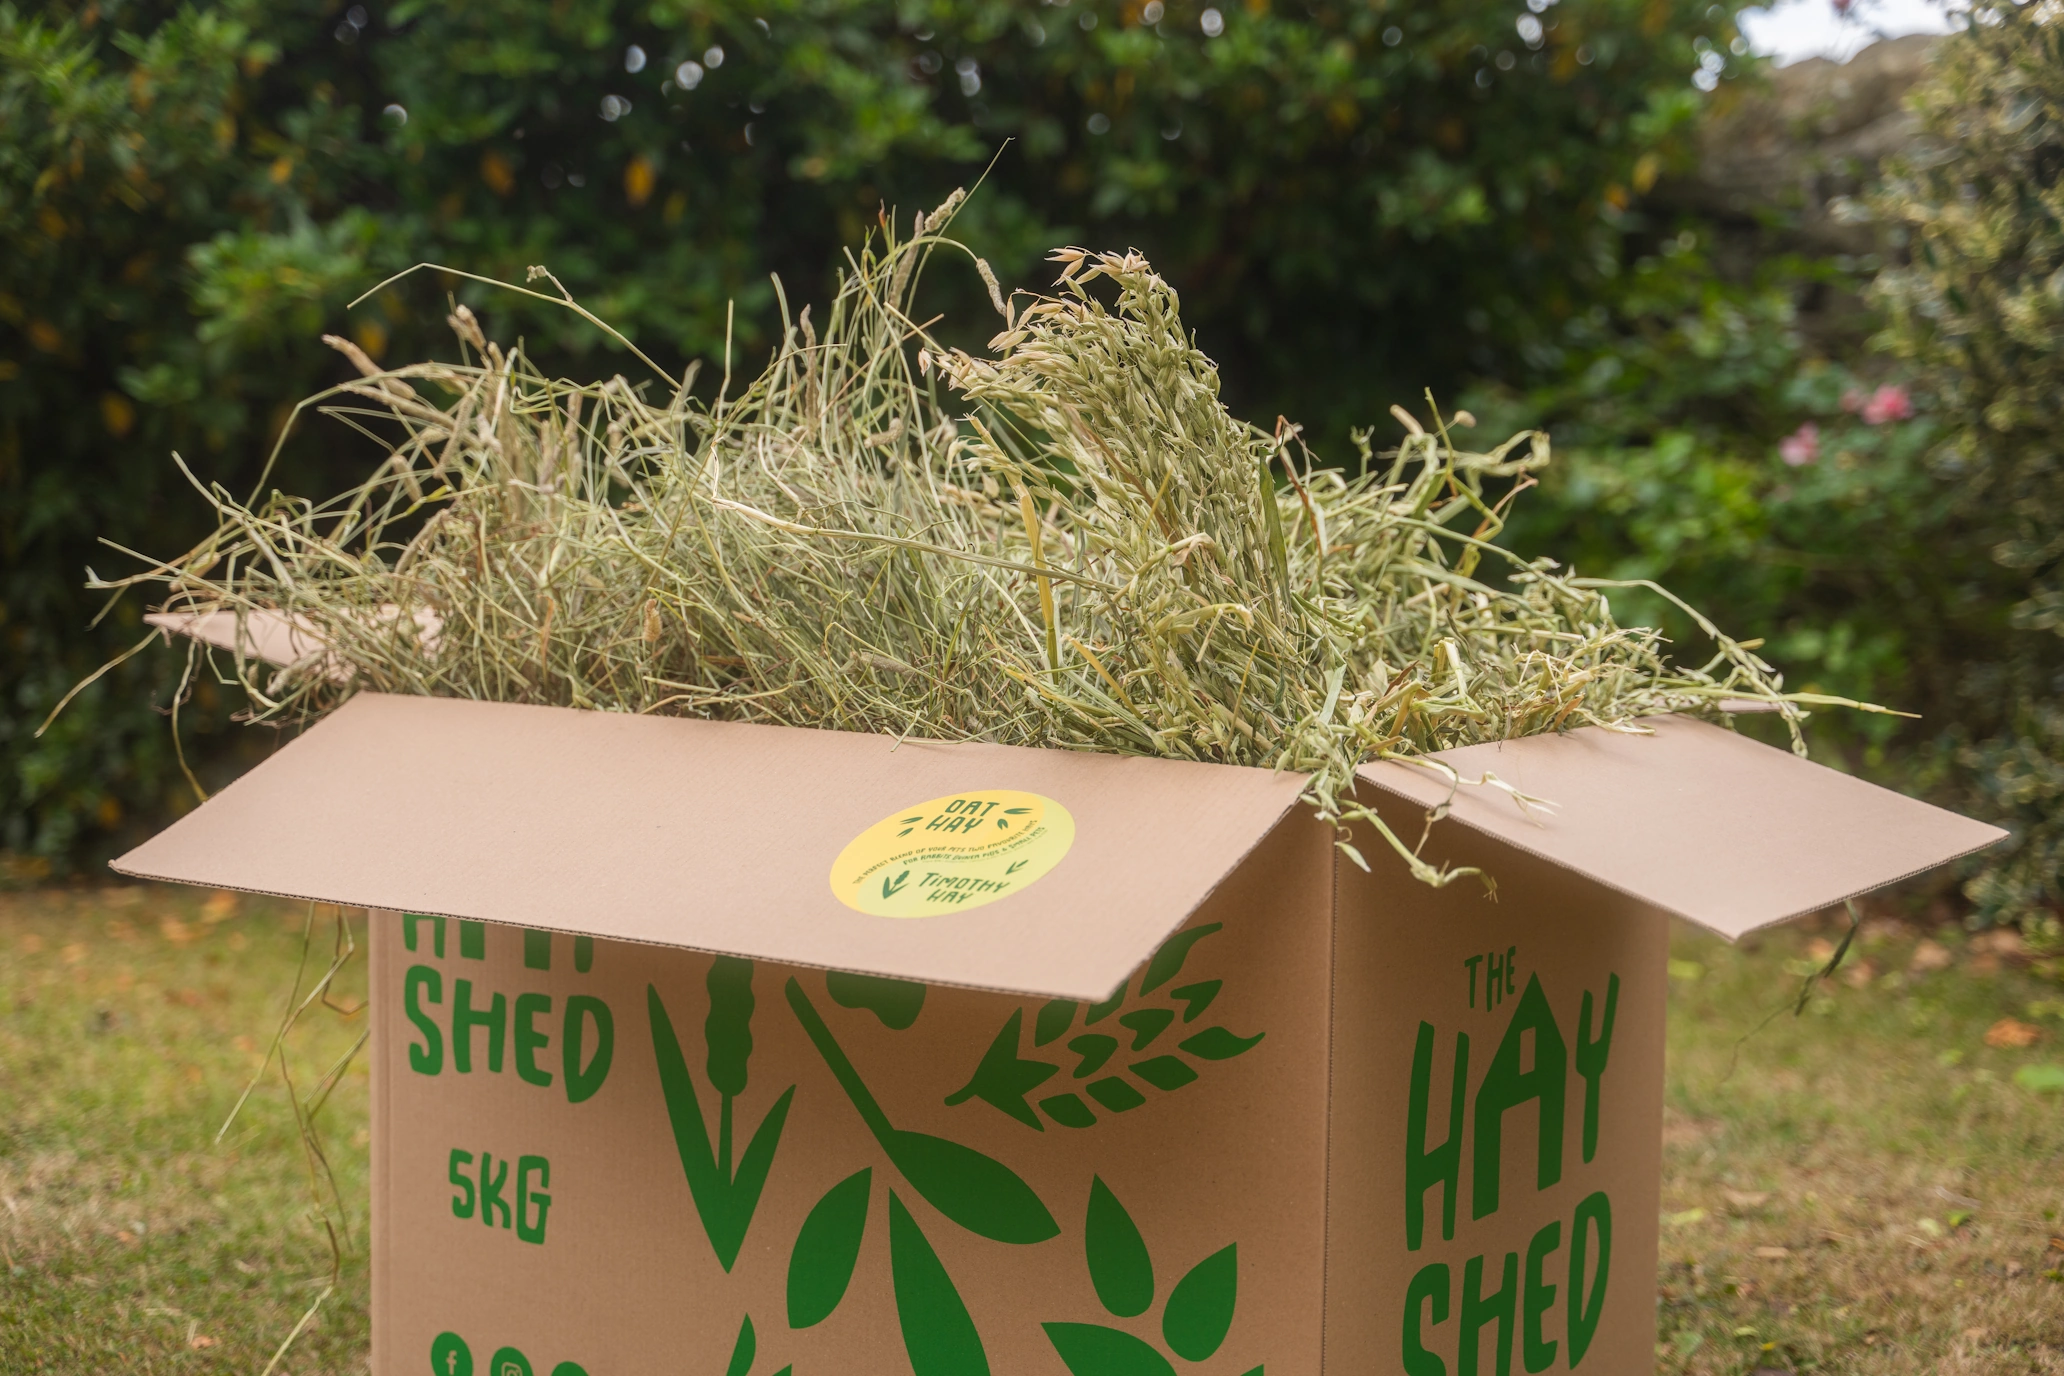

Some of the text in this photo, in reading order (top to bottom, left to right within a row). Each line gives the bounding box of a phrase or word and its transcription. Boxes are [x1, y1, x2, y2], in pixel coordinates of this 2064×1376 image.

[925, 814, 984, 834] HAY
[944, 799, 1000, 817] OAT
[863, 860, 888, 876] PERFECT
[890, 850, 913, 861] BLEND
[987, 832, 1024, 849] FAVOURITE
[903, 857, 918, 865] FOR
[1008, 837, 1031, 849] SMALL
[926, 889, 974, 904] HAY
[1464, 946, 1516, 1012] THE
[404, 964, 614, 1104] SHED
[1405, 971, 1620, 1252] HAY
[449, 1147, 552, 1245] 5KG
[1402, 1191, 1612, 1376] SHED
